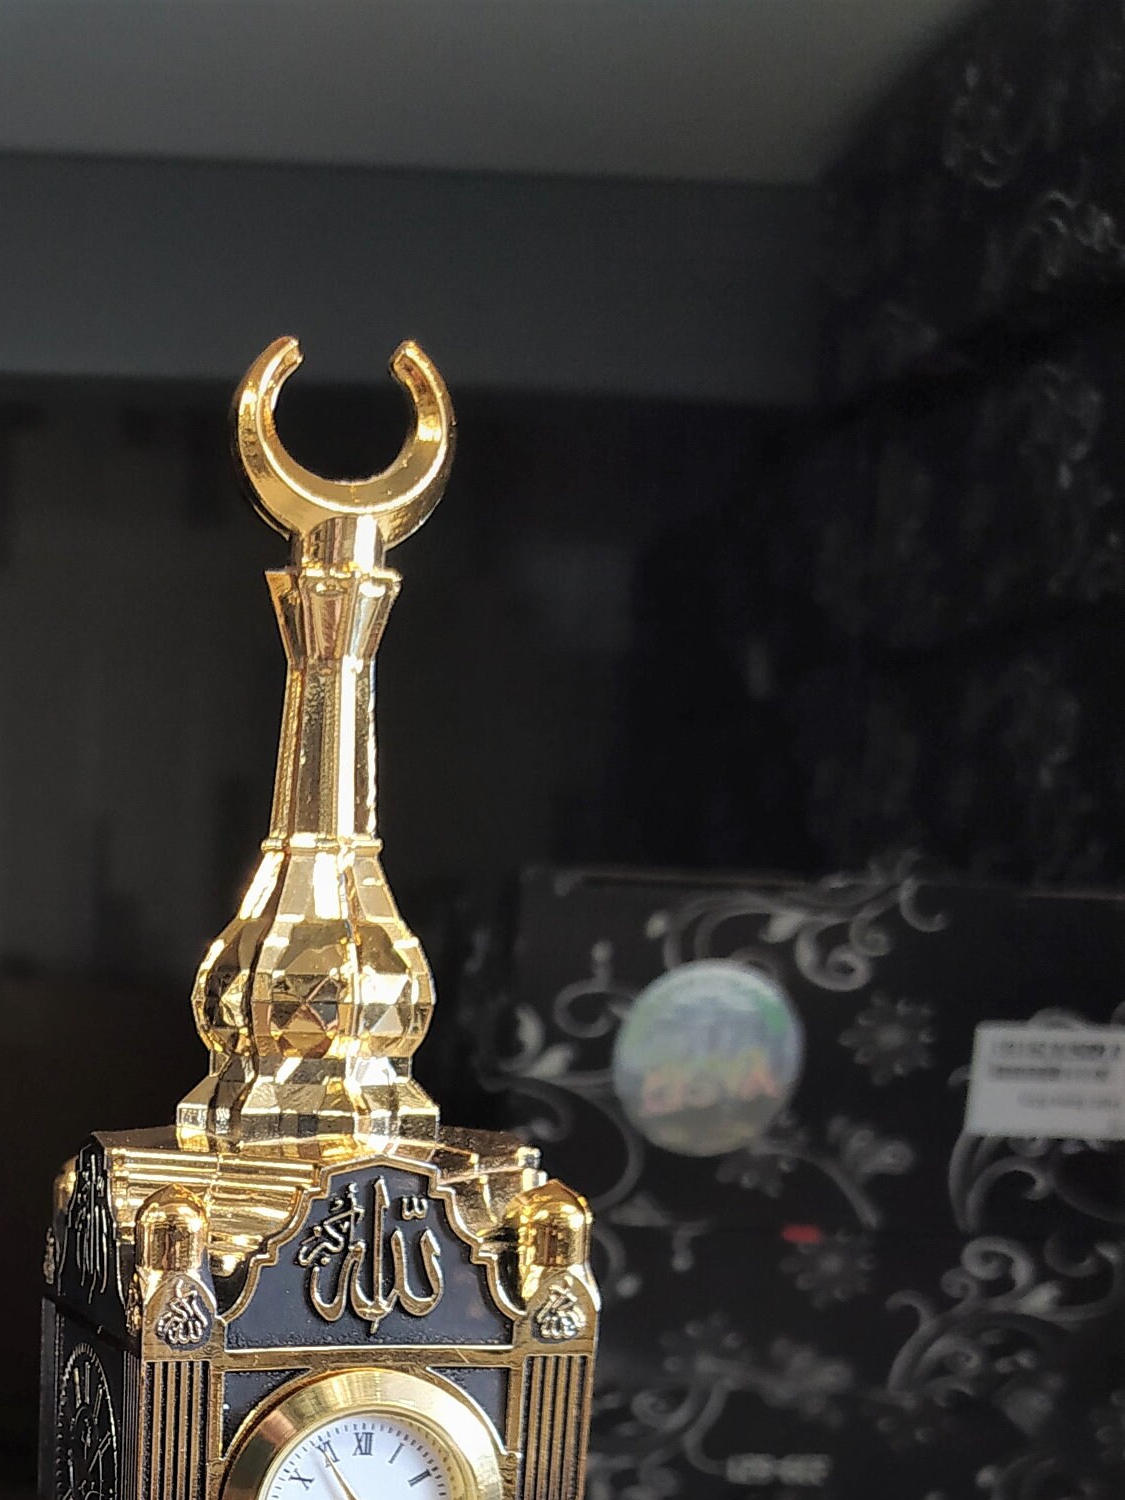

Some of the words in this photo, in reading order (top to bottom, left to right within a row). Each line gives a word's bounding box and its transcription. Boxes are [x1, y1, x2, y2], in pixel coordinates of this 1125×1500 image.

[352, 1432, 375, 1456] XII
[388, 1443, 405, 1464] I
[288, 1467, 315, 1491] X
[408, 1468, 432, 1487] II
